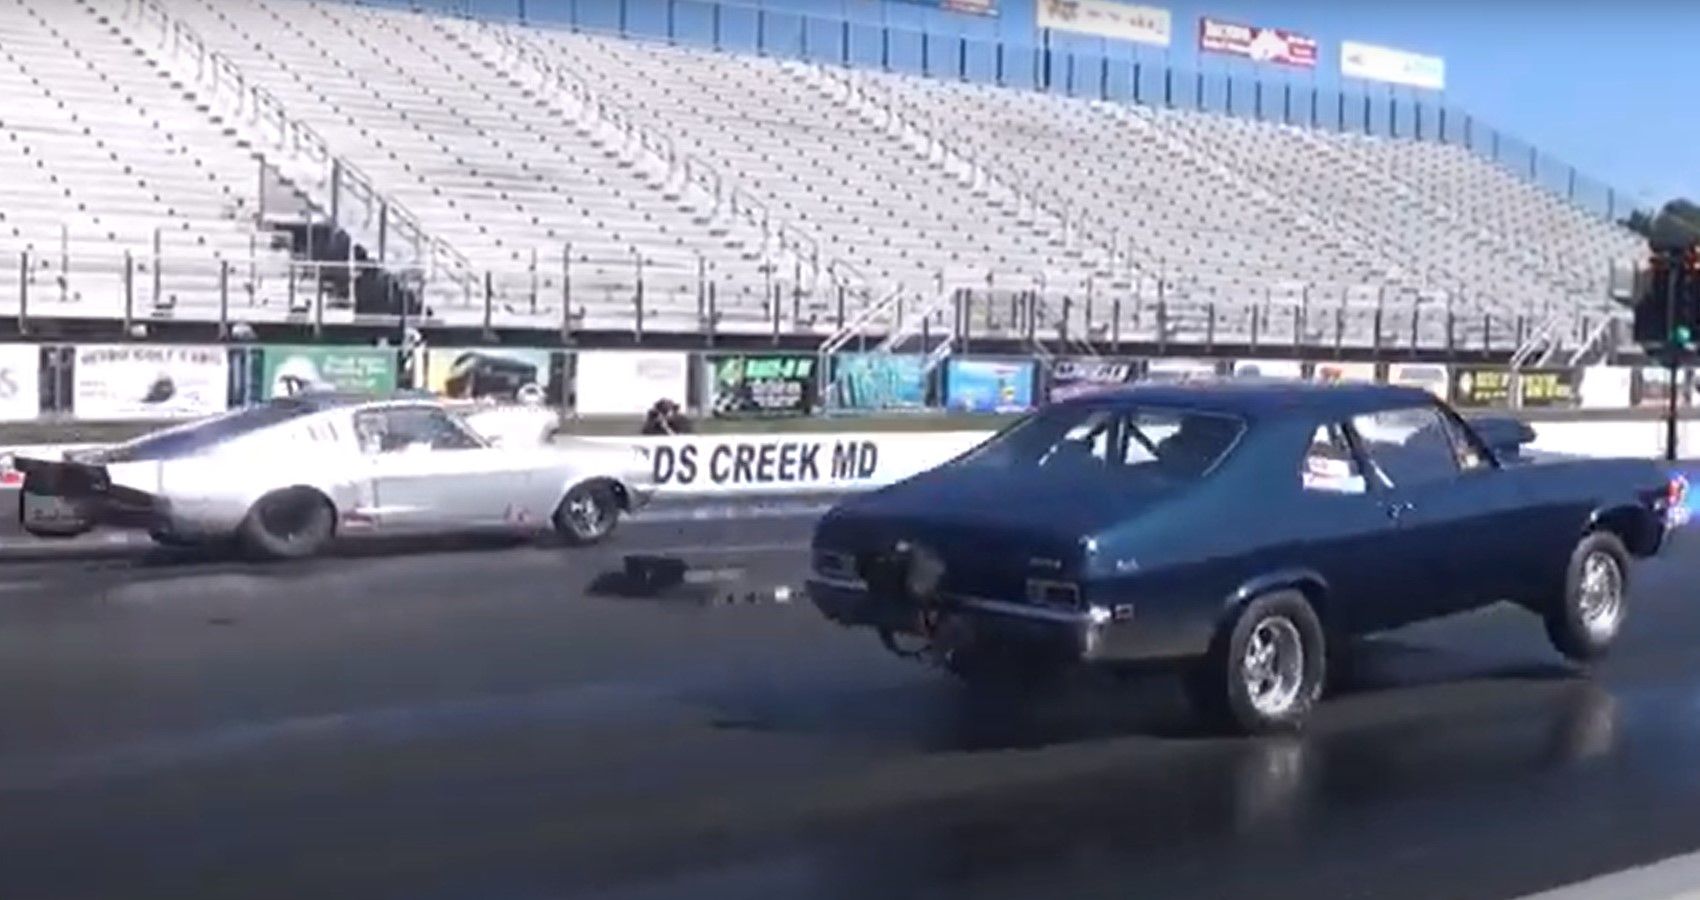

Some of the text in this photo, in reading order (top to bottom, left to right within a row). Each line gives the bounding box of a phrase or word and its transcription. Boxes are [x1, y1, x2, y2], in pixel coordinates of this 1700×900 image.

[635, 439, 878, 485] DS CREEK MD
